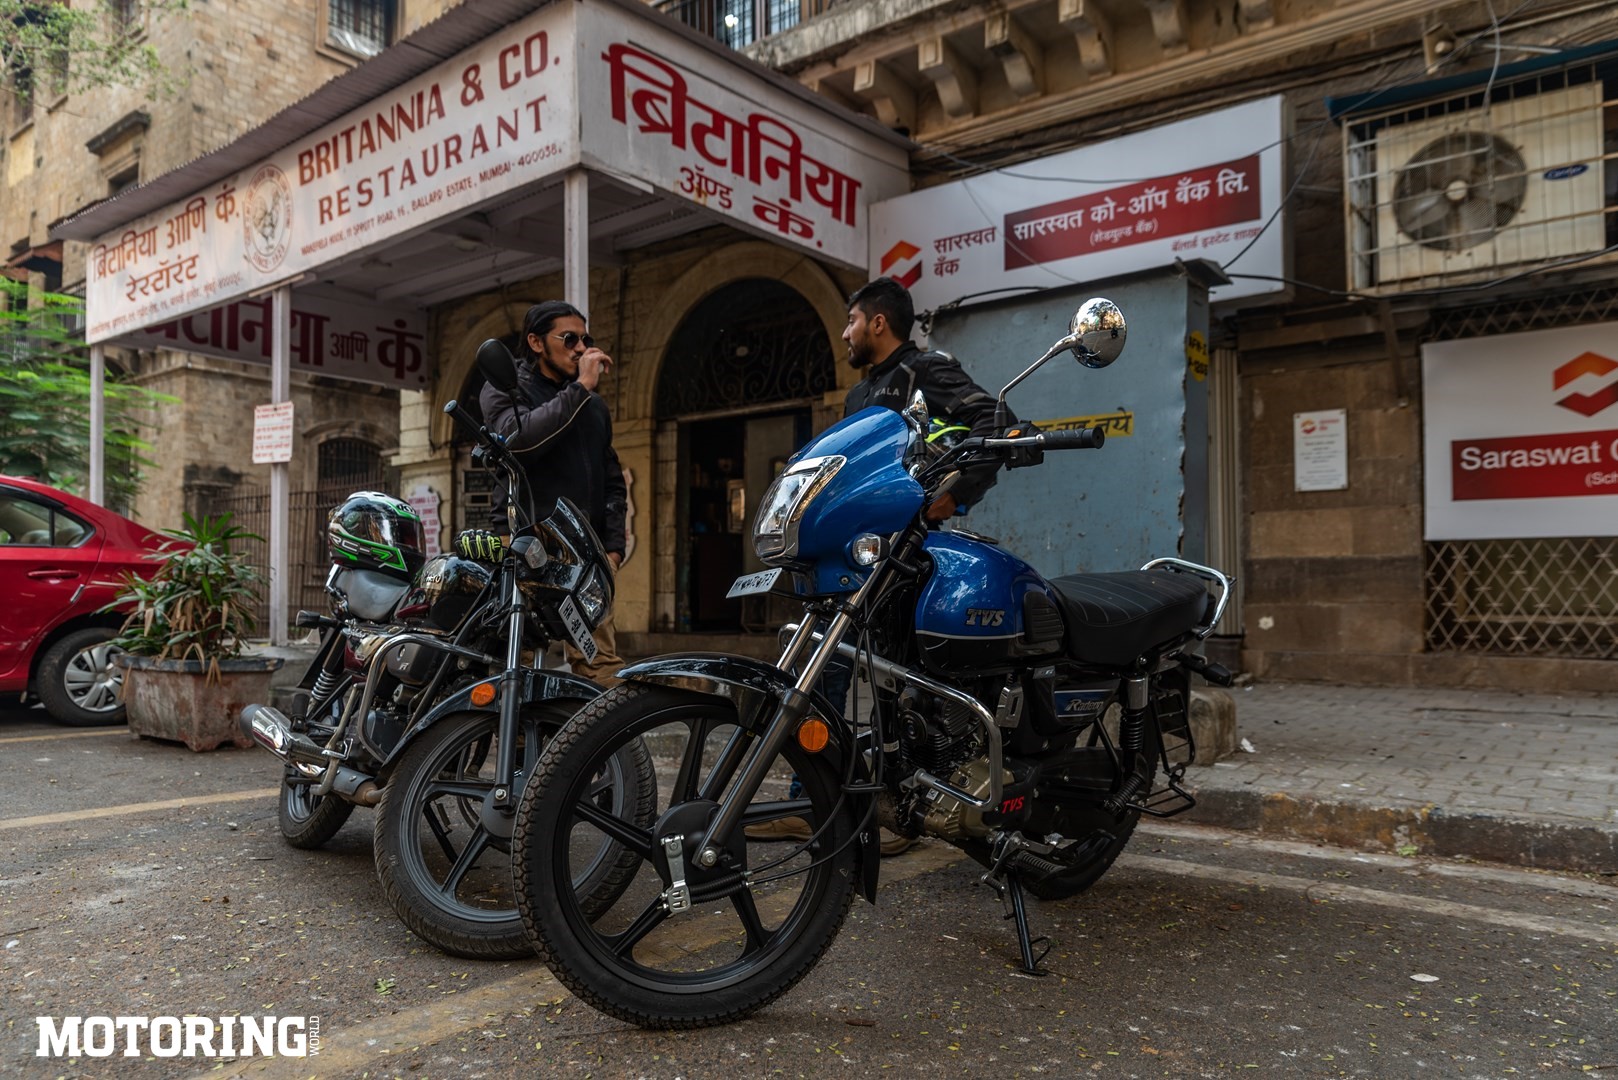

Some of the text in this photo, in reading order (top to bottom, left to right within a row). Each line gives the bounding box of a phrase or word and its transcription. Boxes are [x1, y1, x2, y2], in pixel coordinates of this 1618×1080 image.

[298, 30, 560, 186] BRITANNIA & CO.
[600, 43, 862, 228] ब्रिटानिया
[318, 95, 547, 225] RESTAURANT
[92, 226, 158, 282] ब्रिटानिया
[166, 196, 207, 249] आणि
[215, 184, 239, 223] कं.
[752, 197, 823, 248] कं.
[1013, 208, 1083, 241] सारस्वत
[1176, 176, 1212, 204] बँक
[1216, 168, 1249, 197] लि.
[934, 227, 996, 254] सारस्वत
[934, 256, 960, 277] बँक
[330, 331, 370, 363] आणि
[375, 319, 425, 383] कं.
[1460, 440, 1602, 471] Saraswat
[966, 608, 1005, 626] TVS
[1001, 795, 1025, 814] TVS
